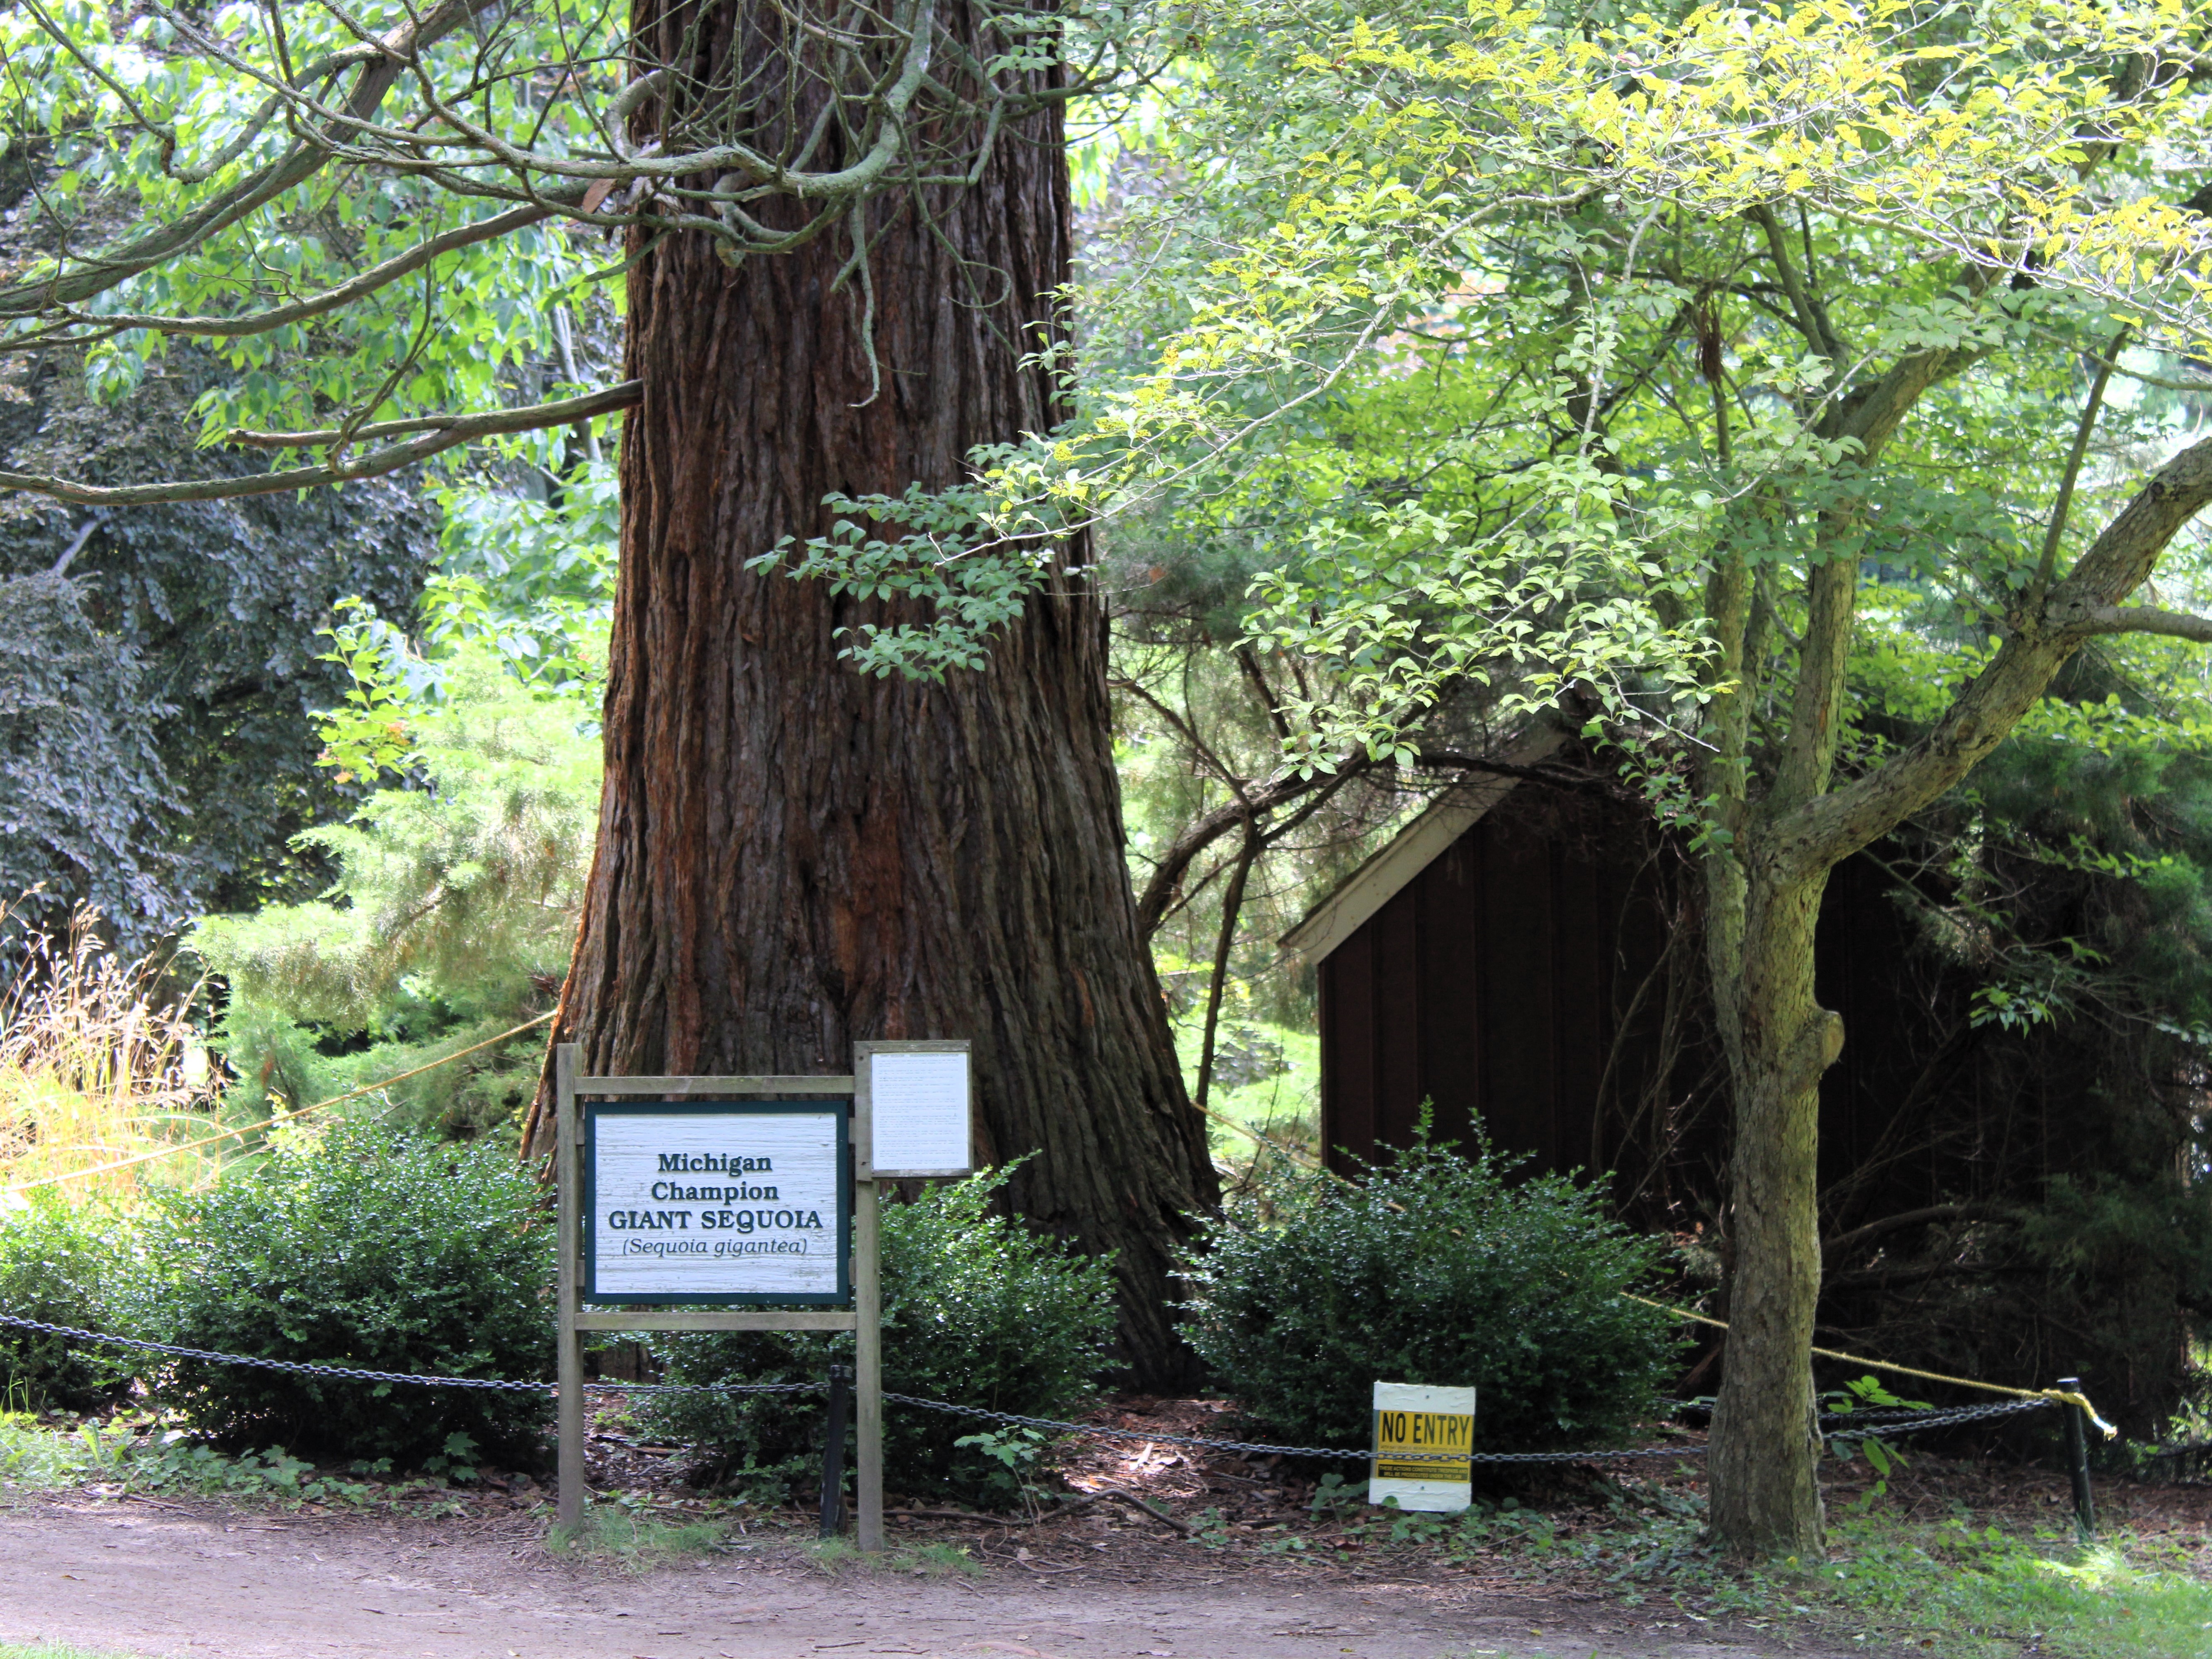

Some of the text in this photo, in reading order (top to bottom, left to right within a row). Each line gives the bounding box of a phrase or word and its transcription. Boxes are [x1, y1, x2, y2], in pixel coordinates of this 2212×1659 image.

[658, 1153, 772, 1177] Michigan
[651, 1181, 779, 1205] Champion
[608, 1210, 823, 1233] GIANT SEQUOIA
[623, 1238, 807, 1257] (Sequoia gigantea)
[1382, 1412, 1470, 1445] NO ENTRY
